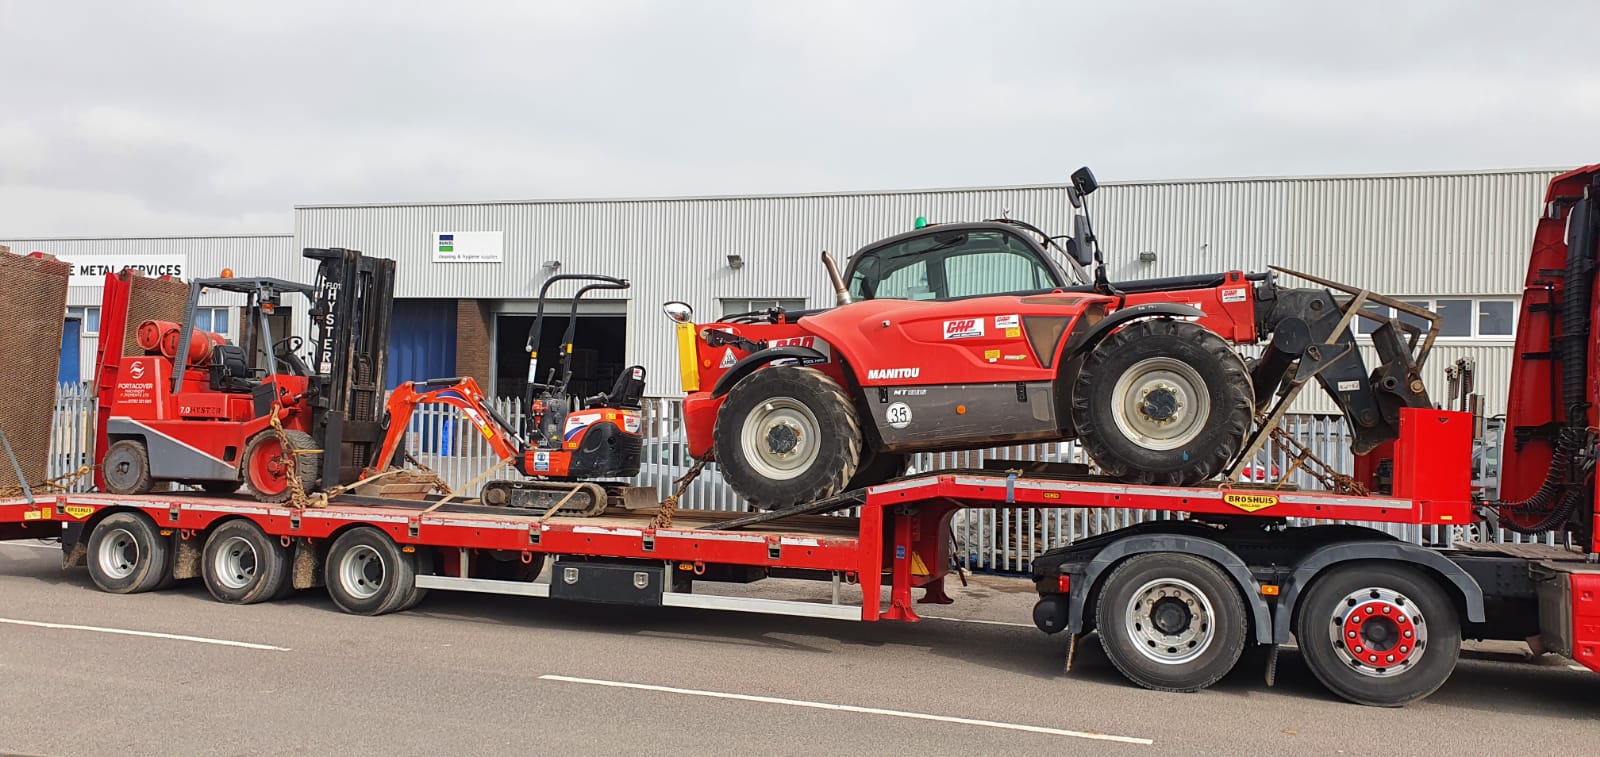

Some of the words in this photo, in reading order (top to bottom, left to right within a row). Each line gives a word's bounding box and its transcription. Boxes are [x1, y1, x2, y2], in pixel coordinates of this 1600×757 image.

[322, 289, 337, 362] HYSTER
[867, 367, 920, 379] MANITOU
[891, 407, 907, 423] 35
[1228, 495, 1274, 504] BROSHUIS
